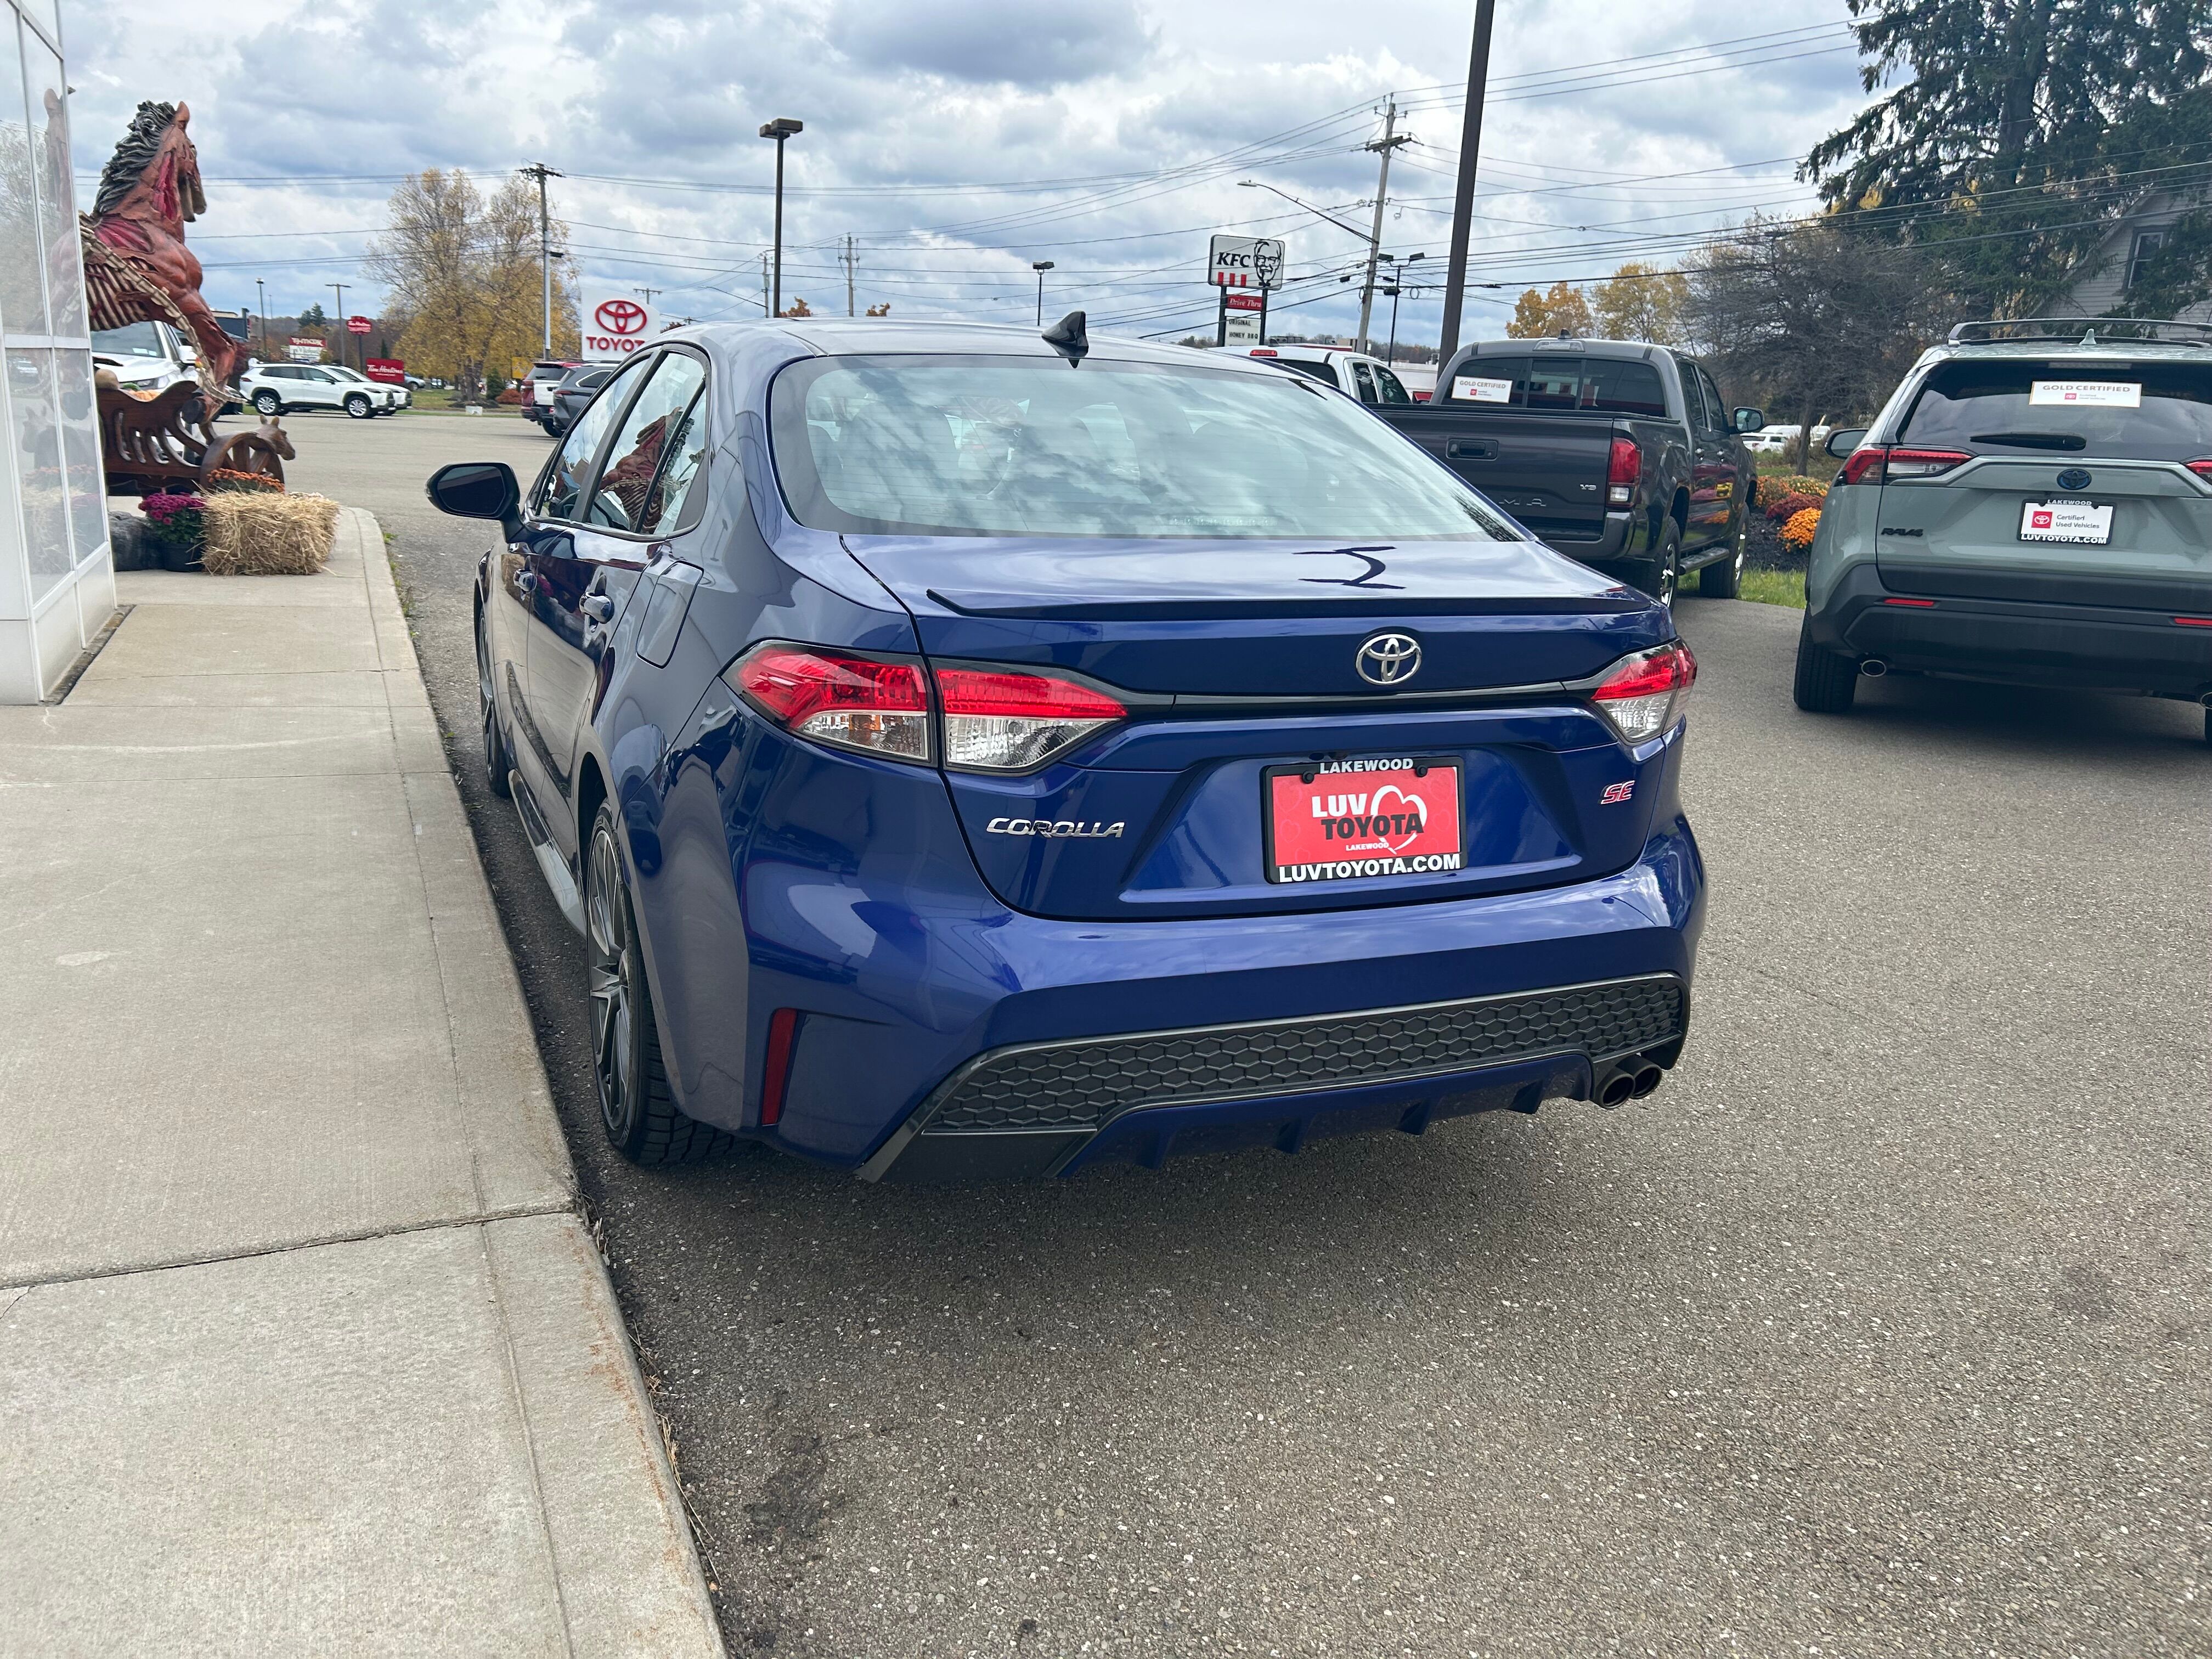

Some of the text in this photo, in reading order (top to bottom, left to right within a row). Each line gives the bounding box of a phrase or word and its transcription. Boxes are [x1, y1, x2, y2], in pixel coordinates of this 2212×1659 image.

[1216, 252, 1251, 268] KFC
[1229, 298, 1261, 307] Drive Thru
[586, 336, 645, 352] TOYOT
[366, 364, 379, 373] Tim
[2021, 533, 2107, 544] LUVTOYOTA.COM
[1319, 758, 1414, 774] LAKEWOOD
[1600, 780, 1635, 805] SE
[1311, 793, 1368, 818] LUV
[986, 817, 1125, 838] COROLLA
[1321, 814, 1424, 840] TOYOTA
[1346, 842, 1390, 851] LAKEWOOD
[1279, 853, 1460, 883] LUVTOYOTA.COM
